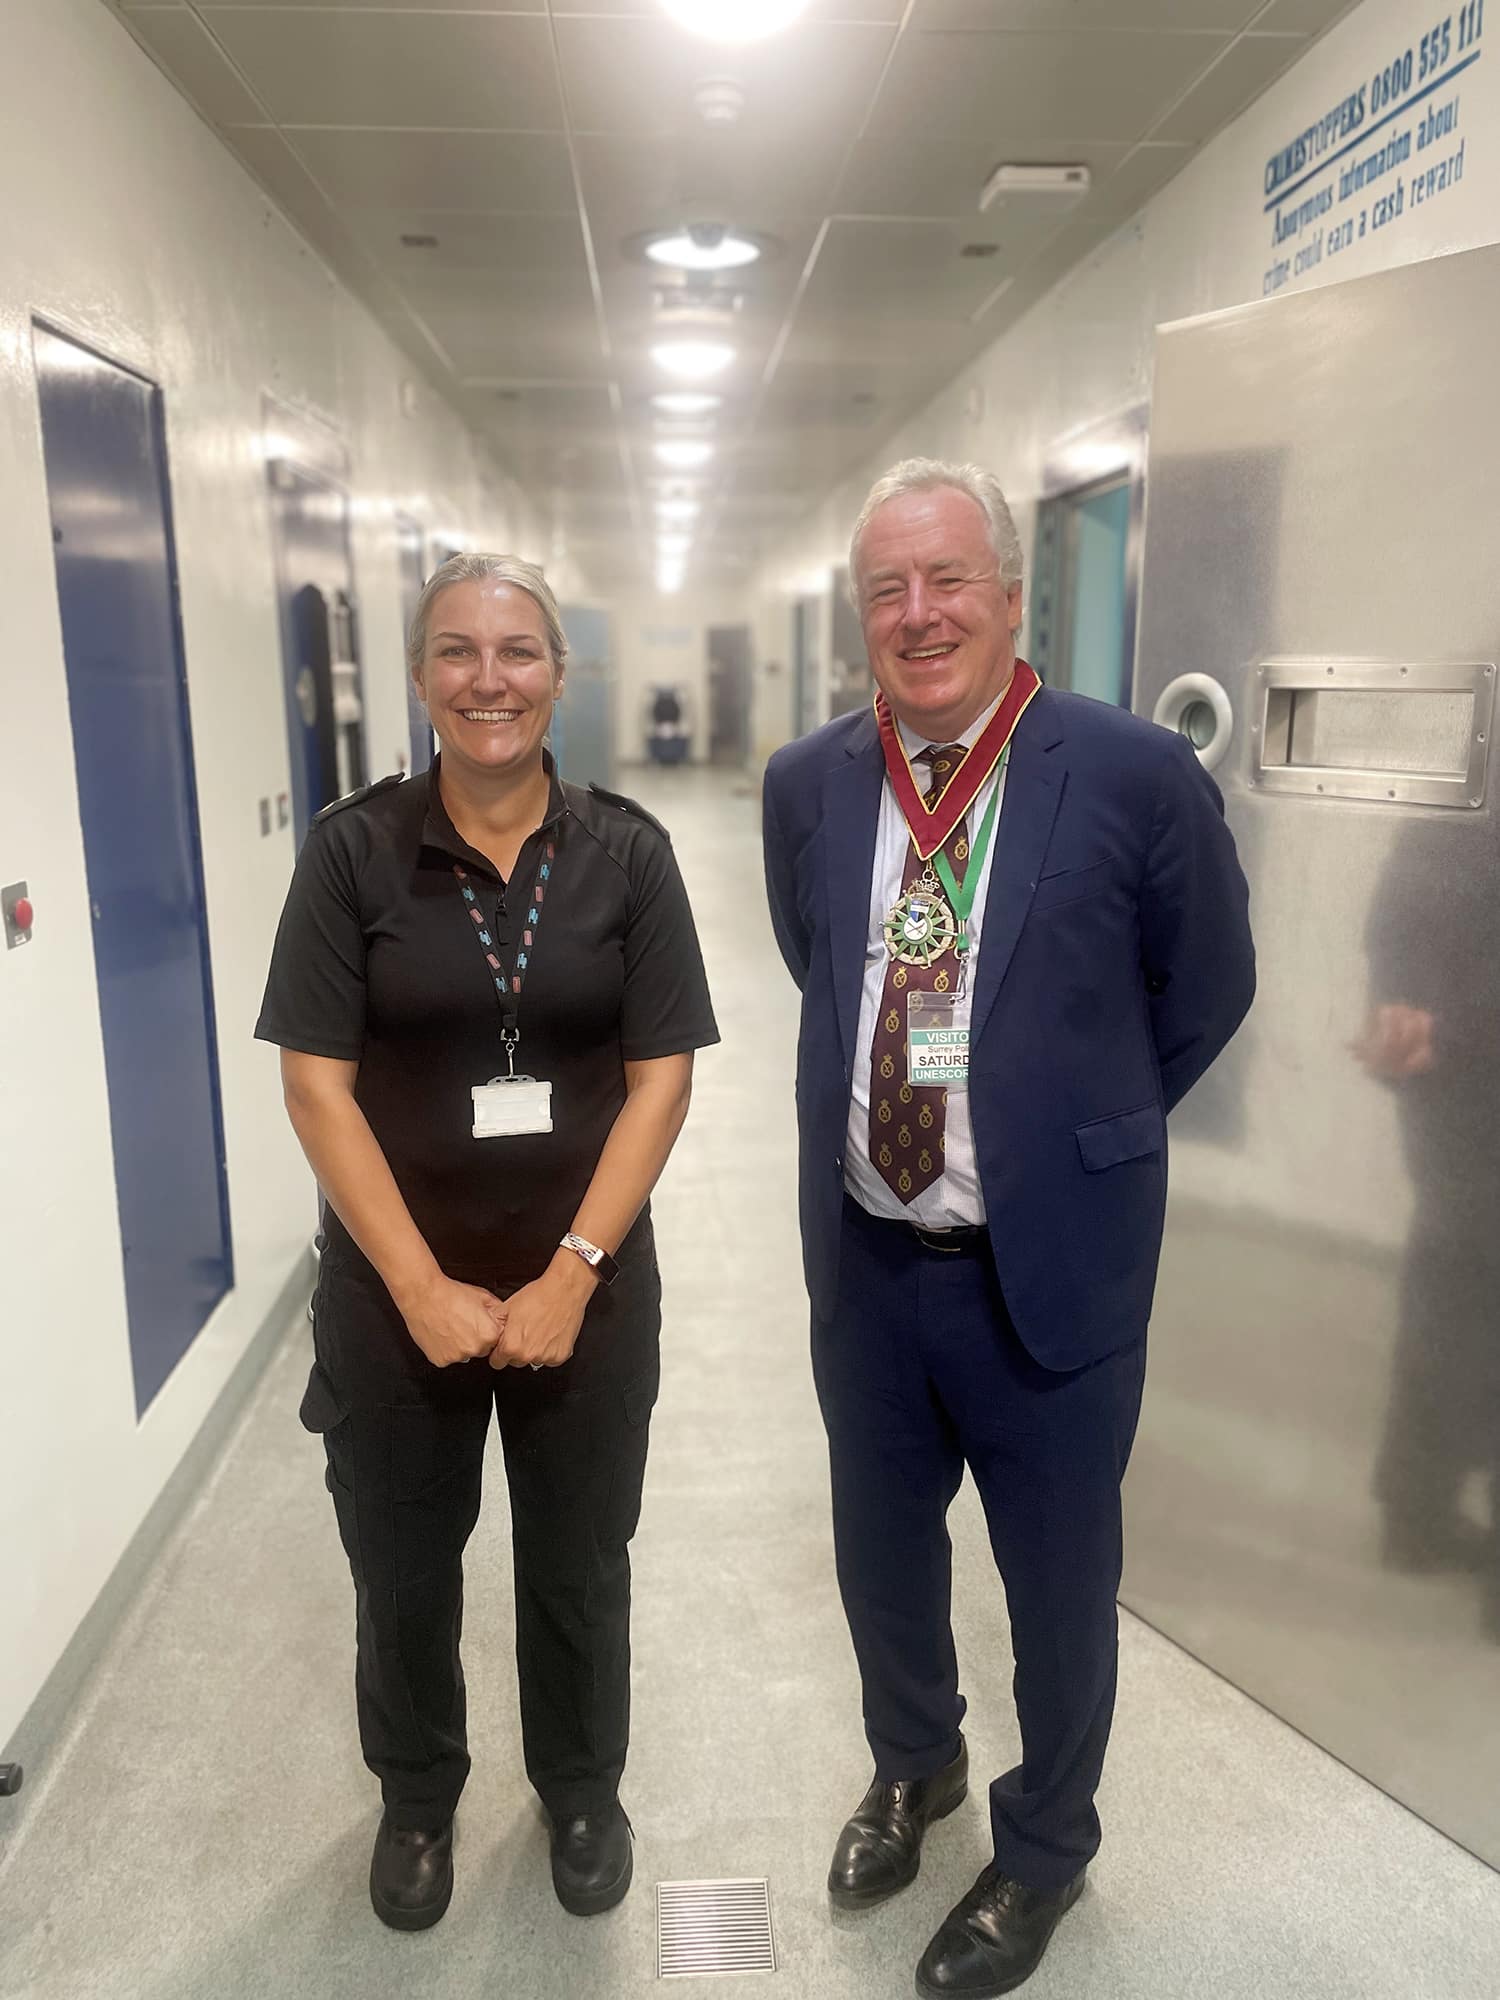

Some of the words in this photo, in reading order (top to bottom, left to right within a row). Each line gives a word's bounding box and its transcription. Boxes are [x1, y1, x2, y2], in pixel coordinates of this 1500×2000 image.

[1371, 49, 1412, 115] 0800
[1418, 16, 1451, 82] 555
[1458, 0, 1483, 52] 111
[1264, 258, 1290, 295] crime
[1294, 228, 1323, 275] could
[1328, 218, 1353, 256] earn
[1358, 210, 1367, 237] a
[1372, 177, 1404, 230] cash
[1410, 138, 1464, 208] reward
[1272, 185, 1332, 247] Anonymous
[1339, 130, 1411, 202] information
[1417, 96, 1459, 151] about
[927, 1045, 953, 1054] Surrey
